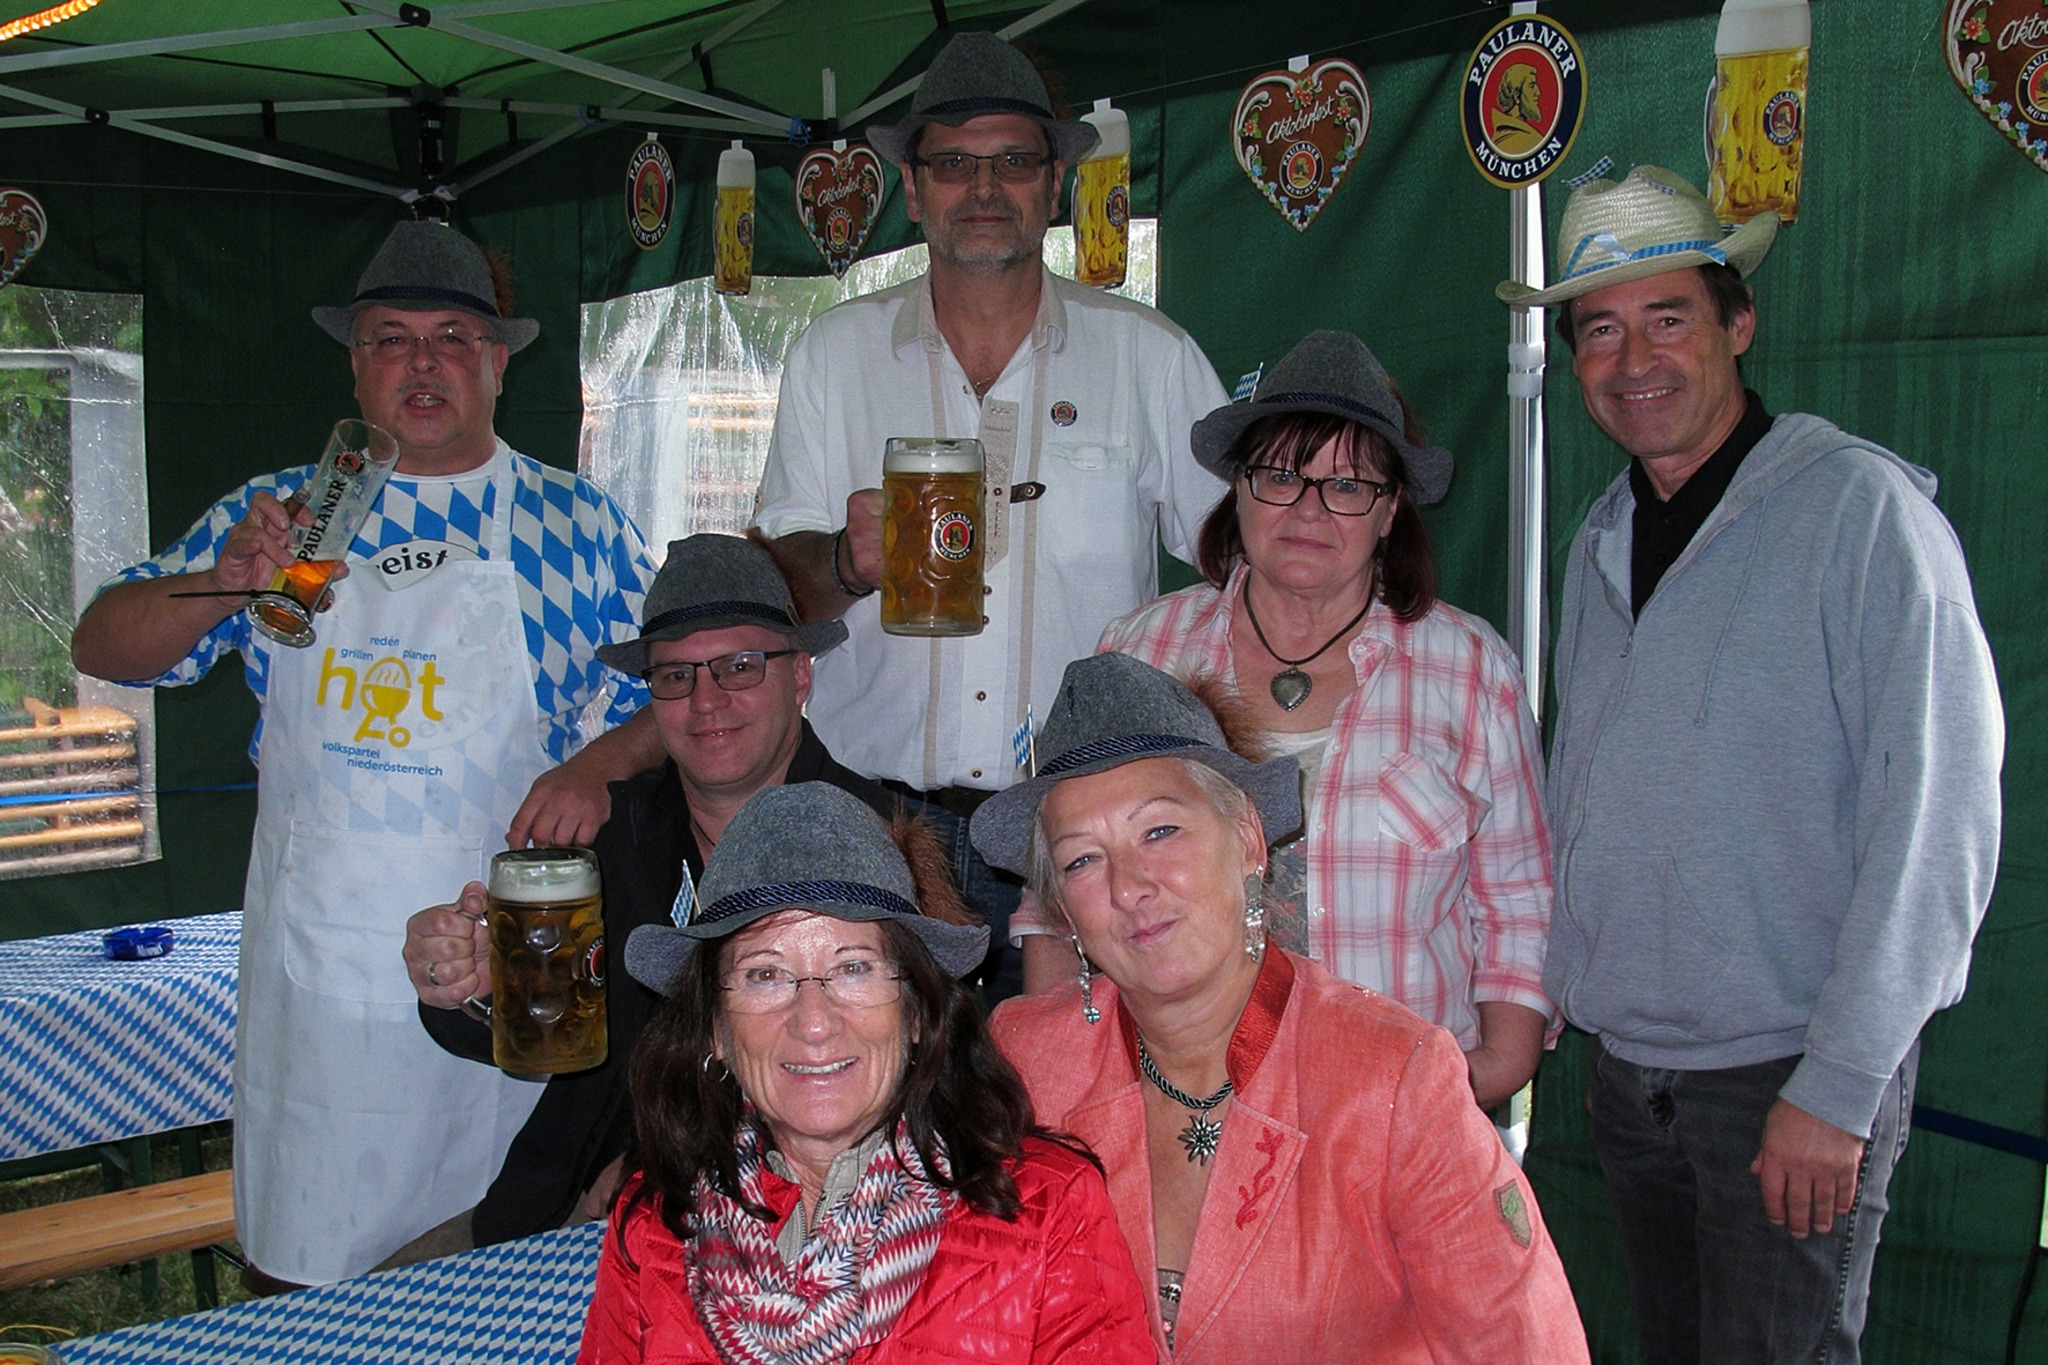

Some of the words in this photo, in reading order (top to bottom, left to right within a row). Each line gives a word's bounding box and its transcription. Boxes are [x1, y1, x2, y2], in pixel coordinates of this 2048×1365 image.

[1469, 22, 1577, 87] PAULANER
[2022, 53, 2048, 80] PAUL
[1266, 96, 1334, 144] Oktoberfest
[630, 145, 672, 184] PAULANER
[1283, 144, 1320, 166] PAULANER
[1476, 136, 1562, 179] MÜNCHEN
[297, 480, 347, 562] PAULANER
[936, 513, 973, 531] PAULANER
[376, 547, 448, 575] eist
[370, 636, 399, 647] reden
[340, 648, 374, 661] grillen
[402, 648, 437, 661] planen
[322, 741, 380, 759] volkspartei
[347, 758, 443, 776] niederösterreich
